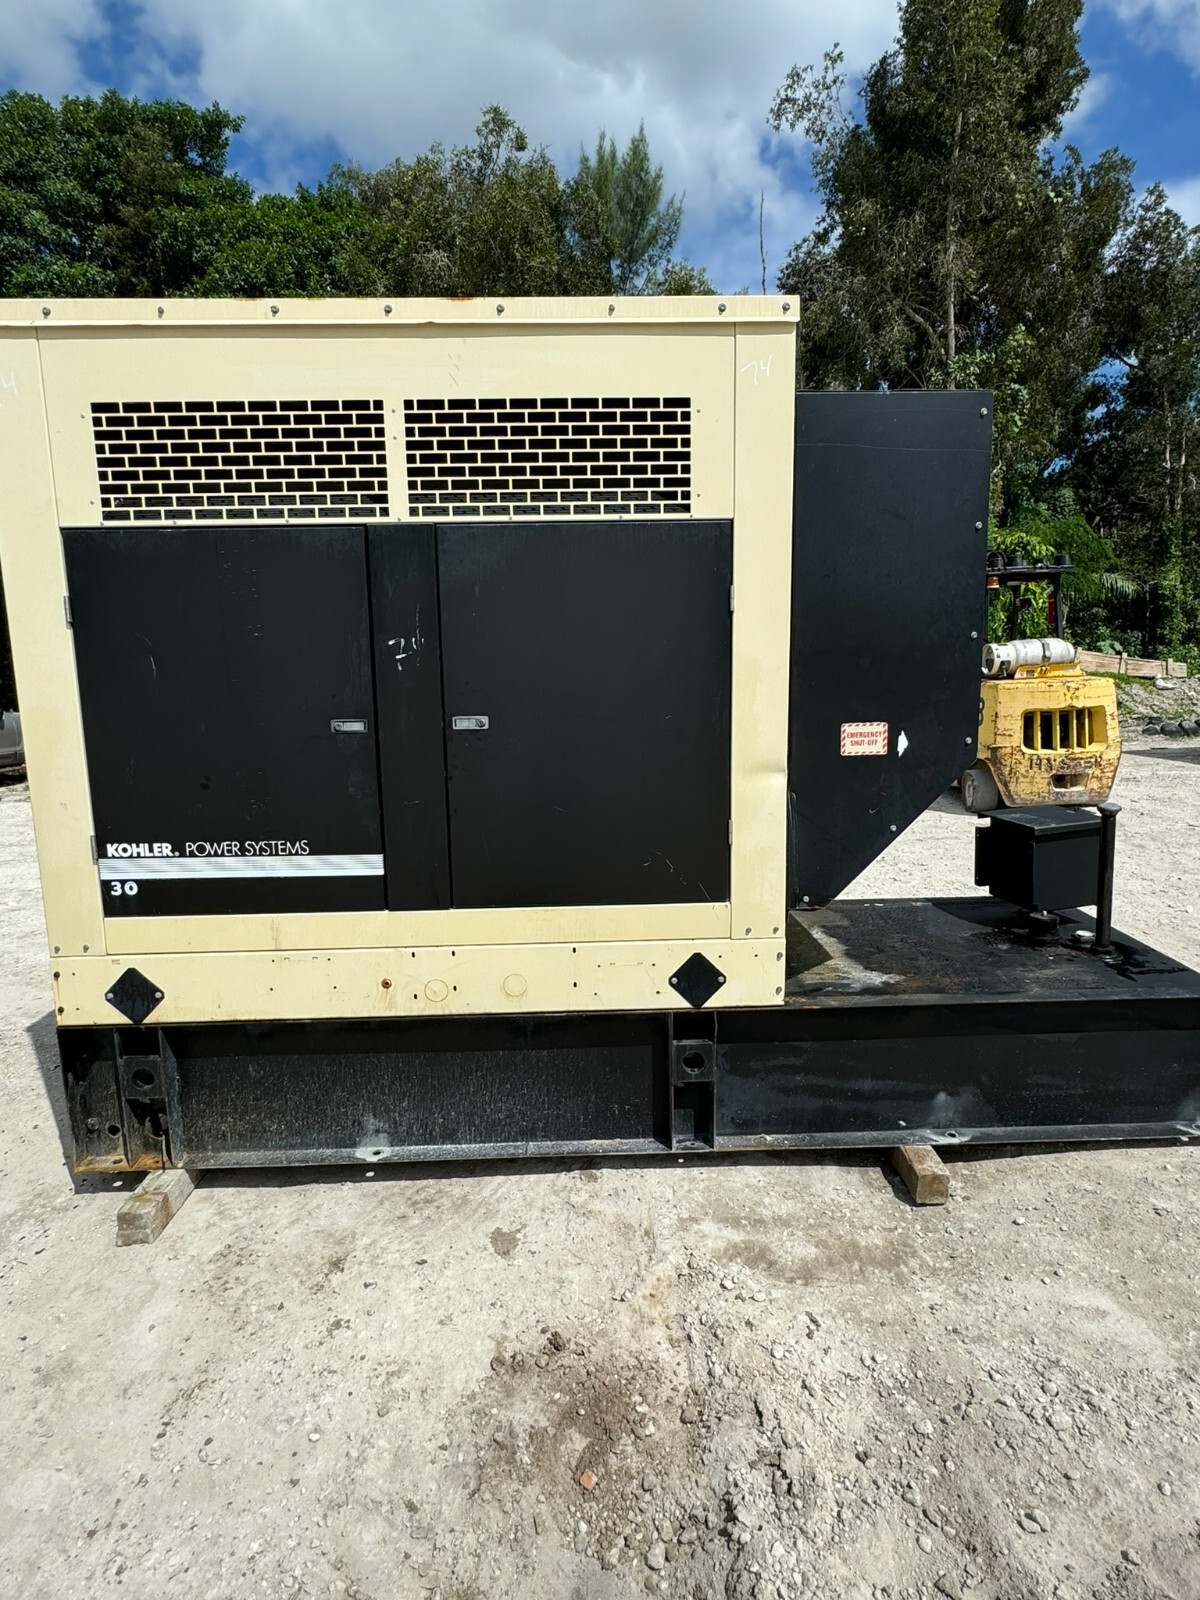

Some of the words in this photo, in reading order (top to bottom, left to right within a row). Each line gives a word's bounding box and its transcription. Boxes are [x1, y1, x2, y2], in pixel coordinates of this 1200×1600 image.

[740, 354, 773, 386] 74
[846, 731, 882, 739] EMERGENCY
[850, 739, 878, 747] SHUT-OFF
[185, 841, 240, 856] POWER
[245, 840, 309, 855] SYSTEMS
[110, 881, 138, 896] 30
